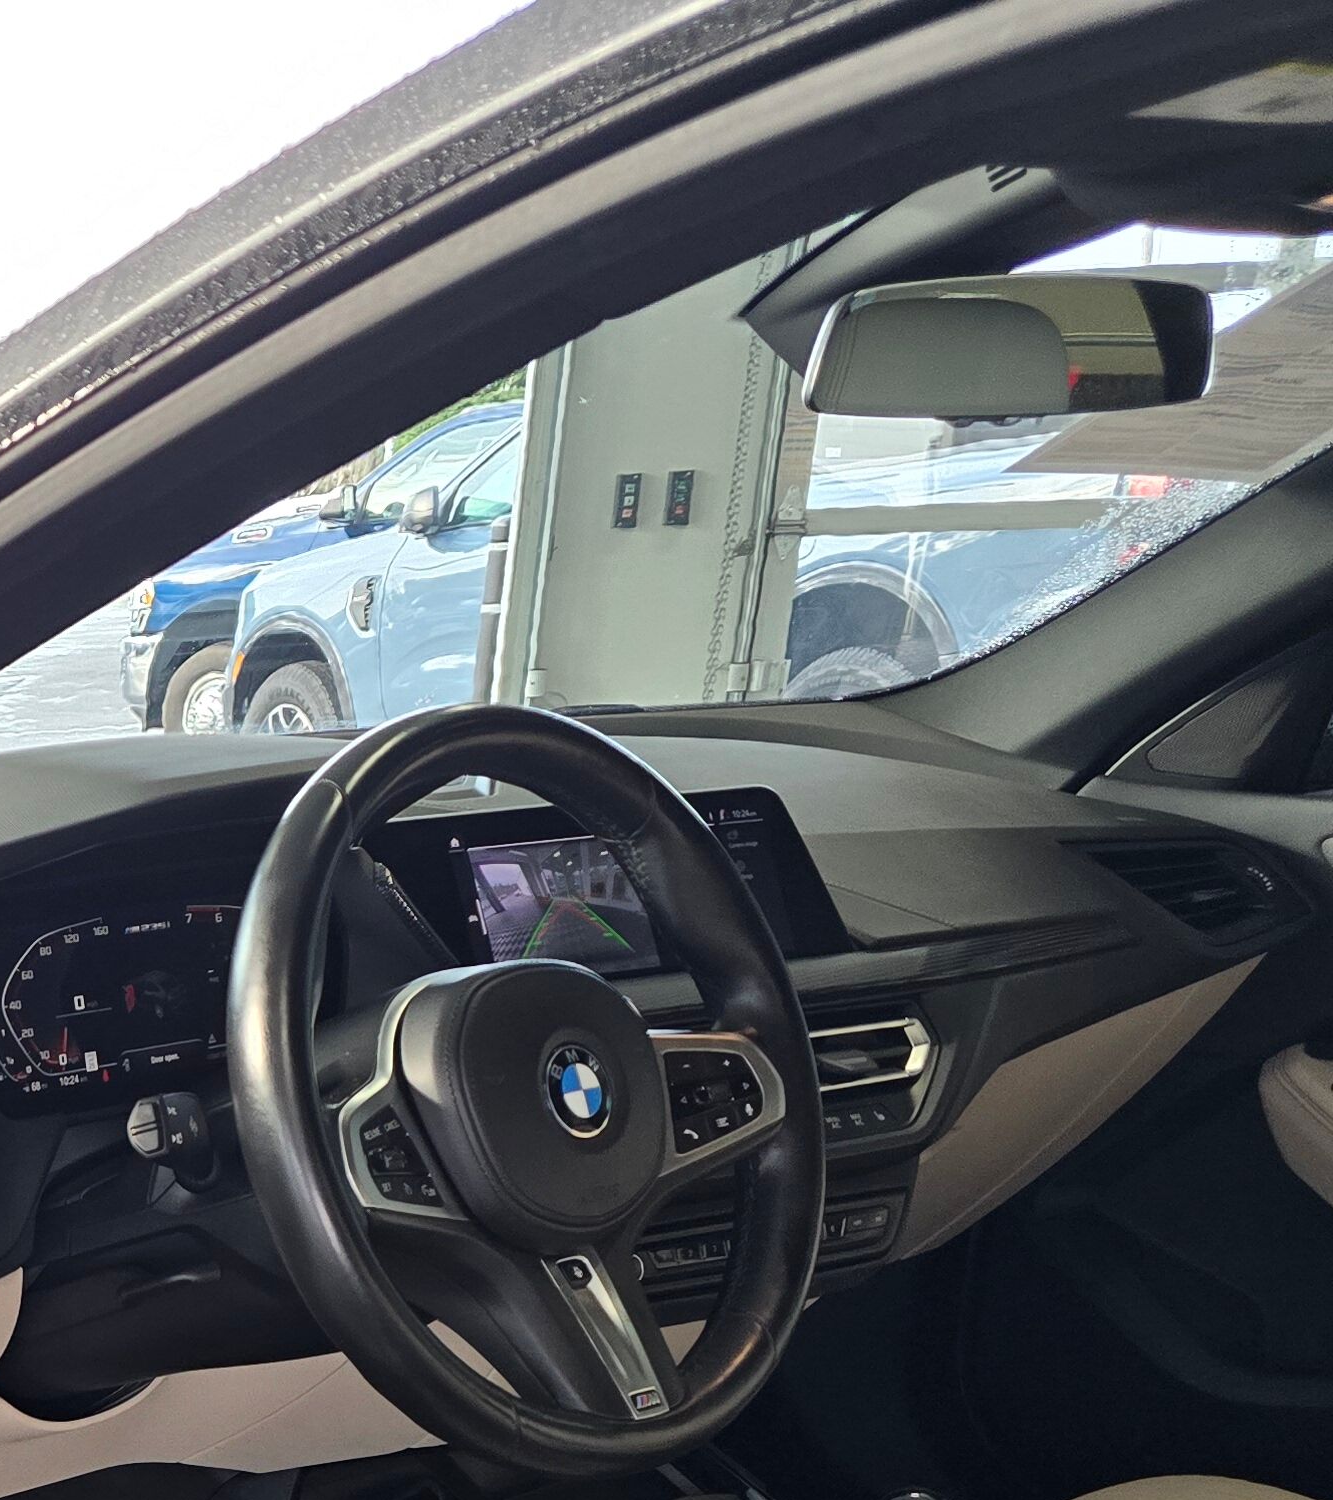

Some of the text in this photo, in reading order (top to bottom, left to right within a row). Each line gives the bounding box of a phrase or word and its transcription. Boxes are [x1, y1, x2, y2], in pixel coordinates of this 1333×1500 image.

[185, 913, 192, 923] 7
[215, 912, 222, 922] 6
[93, 925, 109, 936] 160
[64, 933, 80, 944] 120
[39, 946, 52, 956] 80
[21, 970, 34, 980] 60
[9, 1000, 22, 1010] 40
[74, 995, 85, 1011] 0
[21, 1028, 34, 1037] 20
[40, 1050, 50, 1060] 10
[58, 1053, 68, 1066] 0
[551, 1048, 600, 1080] BMW
[59, 1074, 80, 1087] 10:24
[31, 1081, 42, 1092] 68
